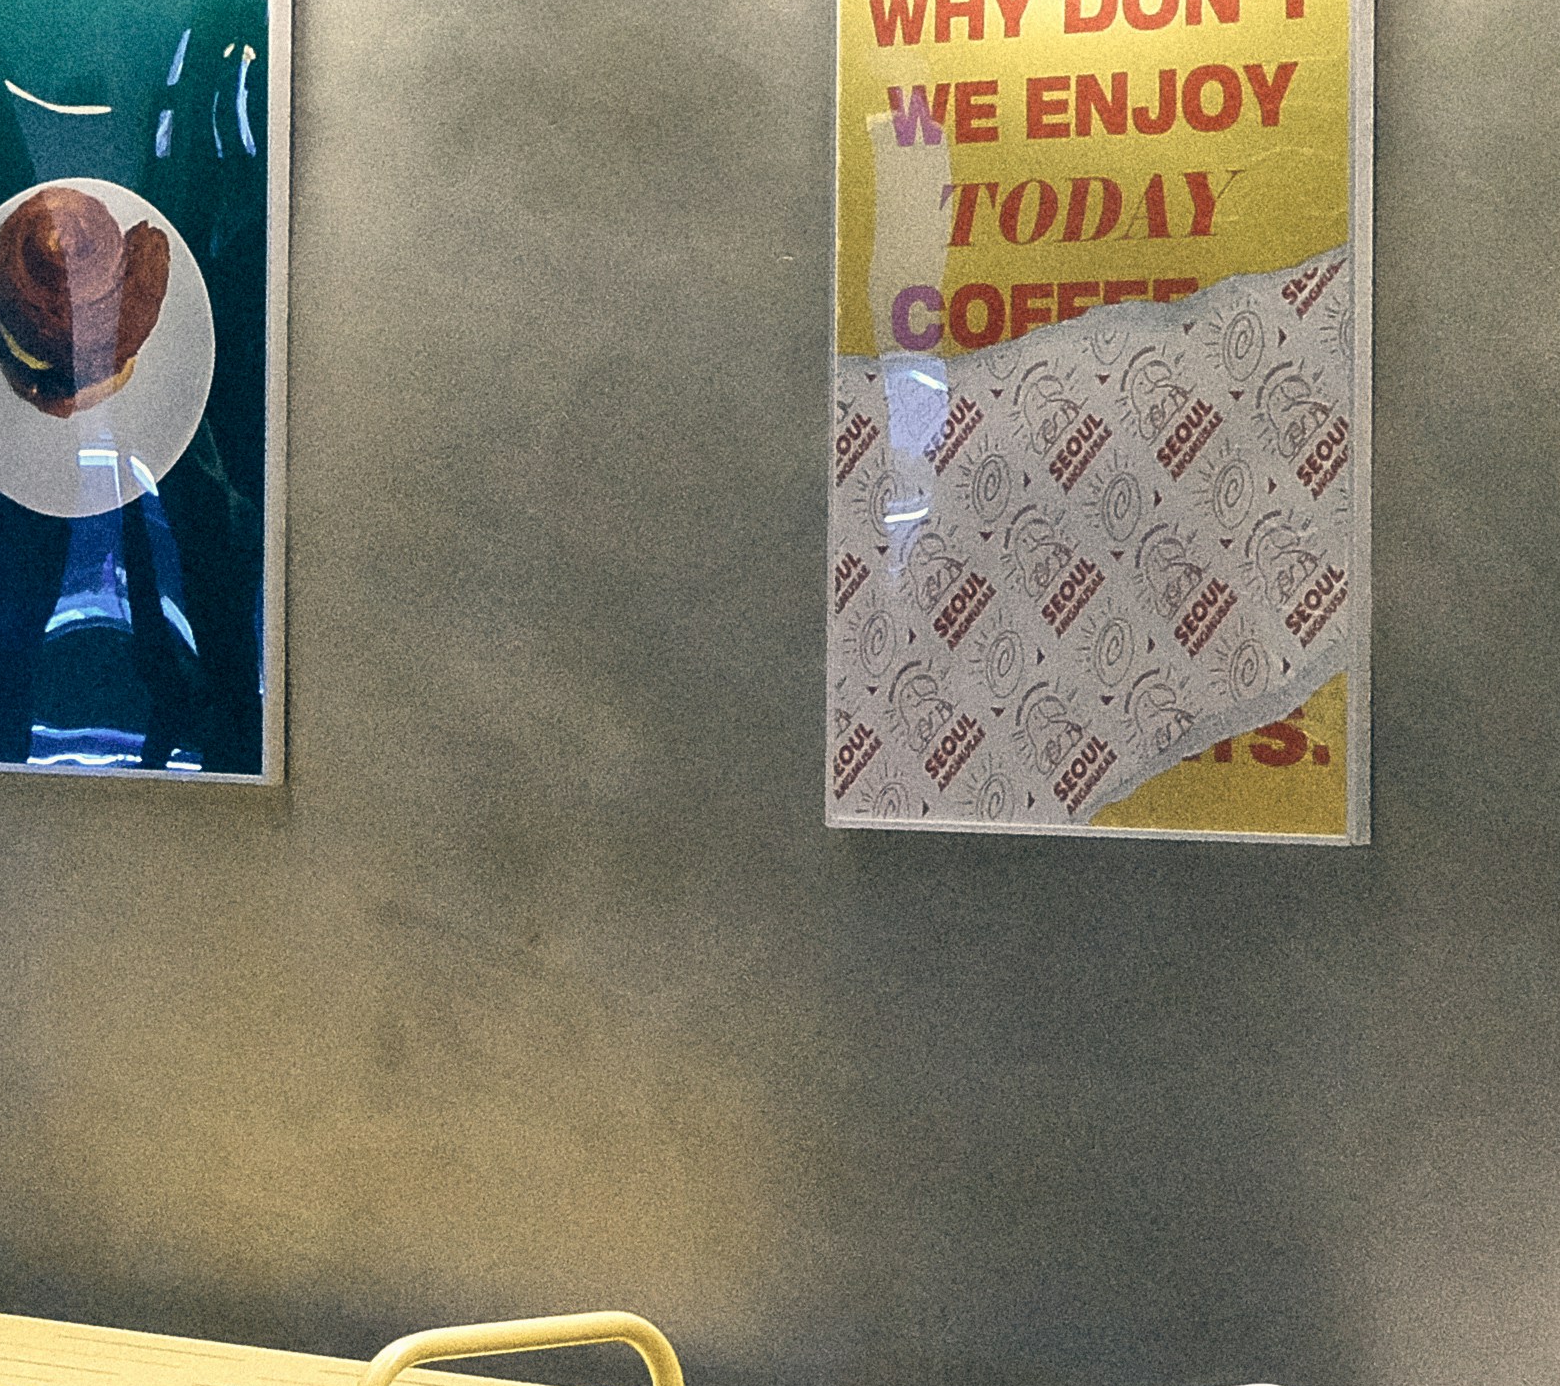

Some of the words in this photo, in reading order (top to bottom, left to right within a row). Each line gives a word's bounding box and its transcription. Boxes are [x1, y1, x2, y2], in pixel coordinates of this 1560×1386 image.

[887, 80, 1000, 148] WE
[1026, 61, 1299, 140] ENJOY
[939, 169, 1244, 248] TODAY
[1049, 414, 1104, 482] SEOUL
[1157, 398, 1213, 468] SEOUL
[933, 571, 987, 639] SEOUL
[1041, 557, 1096, 626] SEOUL
[1174, 577, 1229, 647] SEOUL
[1284, 564, 1345, 635] SEOUL
[924, 713, 978, 780] SEOUL
[1053, 735, 1109, 803] SEOUL
